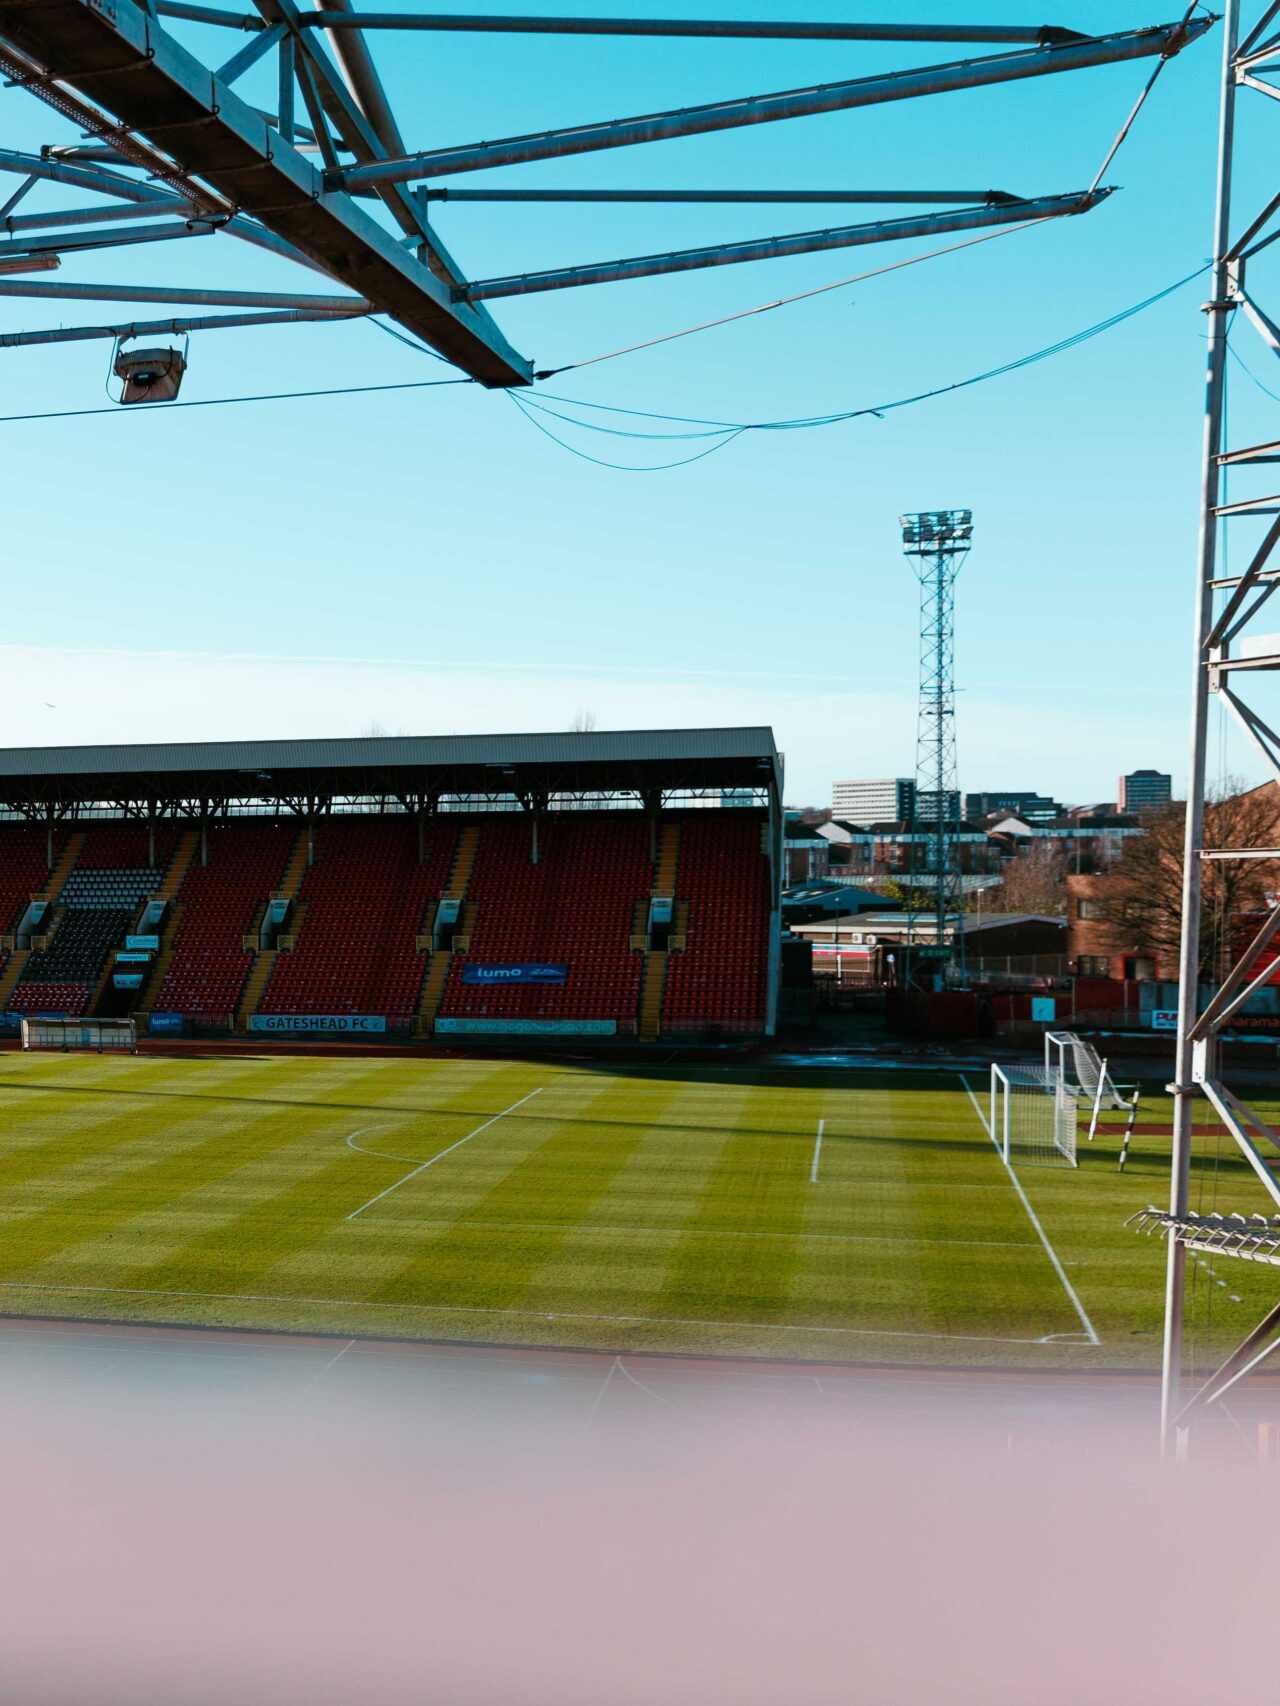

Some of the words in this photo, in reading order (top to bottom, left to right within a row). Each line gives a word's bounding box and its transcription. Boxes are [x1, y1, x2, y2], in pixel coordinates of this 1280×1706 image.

[477, 967, 522, 977] lumo
[152, 1017, 170, 1025] lumo
[266, 1017, 348, 1029] GATESHEAD
[352, 1018, 369, 1029] FC
